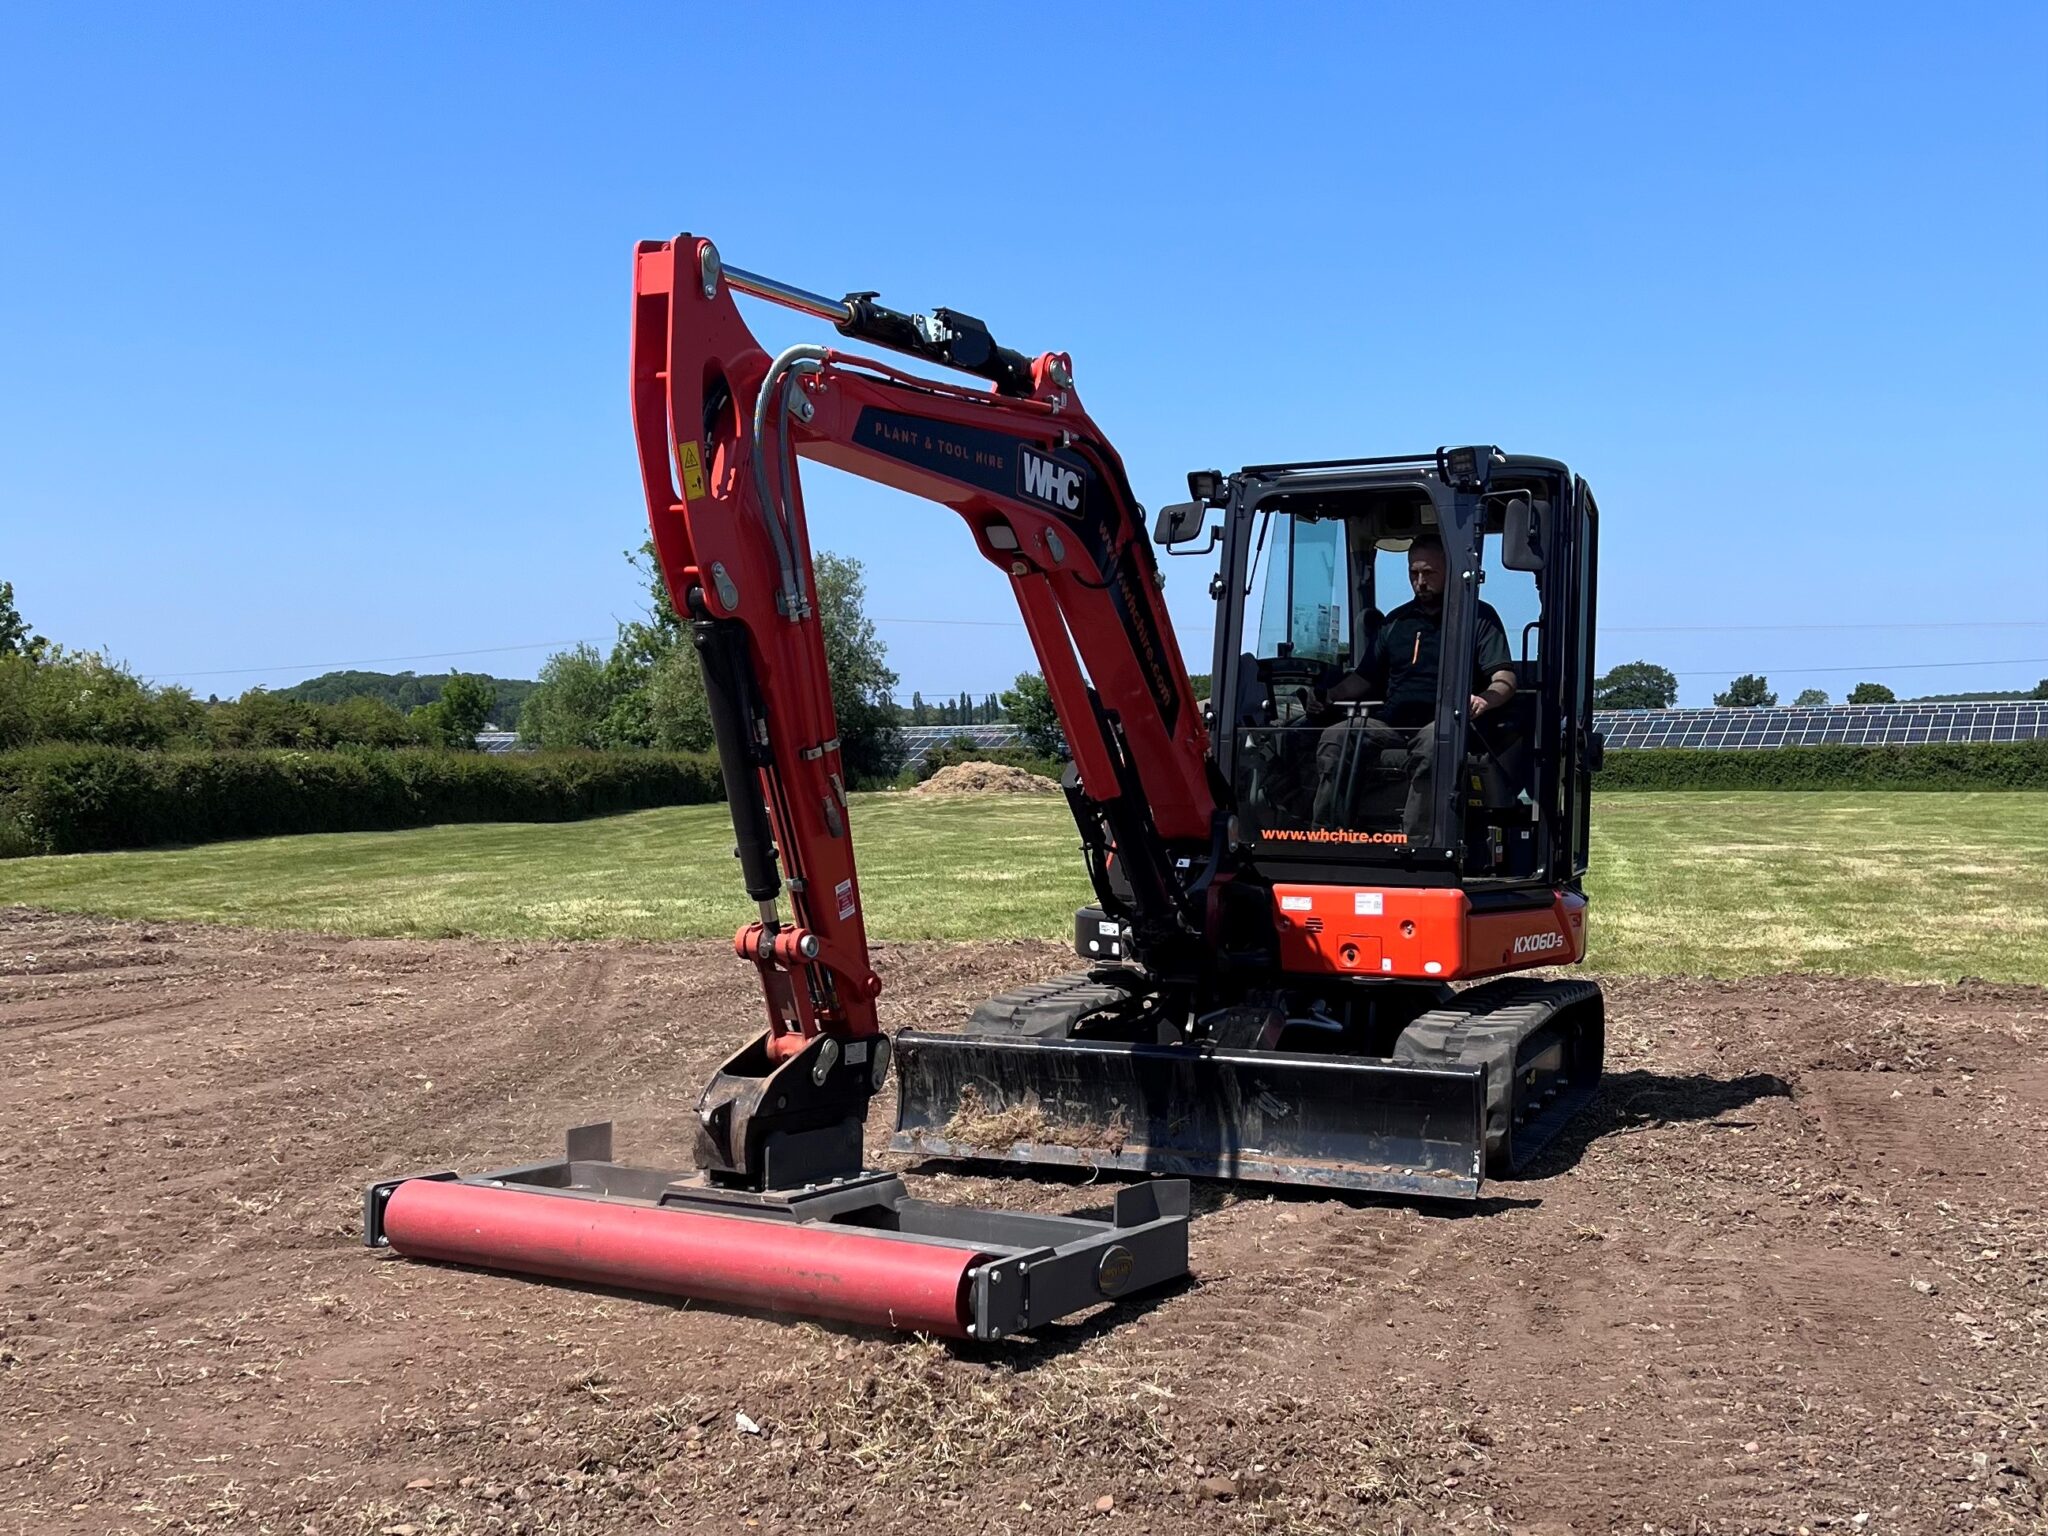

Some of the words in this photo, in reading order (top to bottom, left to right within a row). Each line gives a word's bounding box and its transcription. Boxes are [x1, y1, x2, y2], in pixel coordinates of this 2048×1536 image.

[875, 422, 918, 445] PLANT
[924, 436, 932, 449] &
[938, 439, 968, 459] TOOL
[975, 451, 1003, 469] HIRE
[1023, 451, 1080, 510] WHC
[1261, 828, 1408, 844] www.whchire.com
